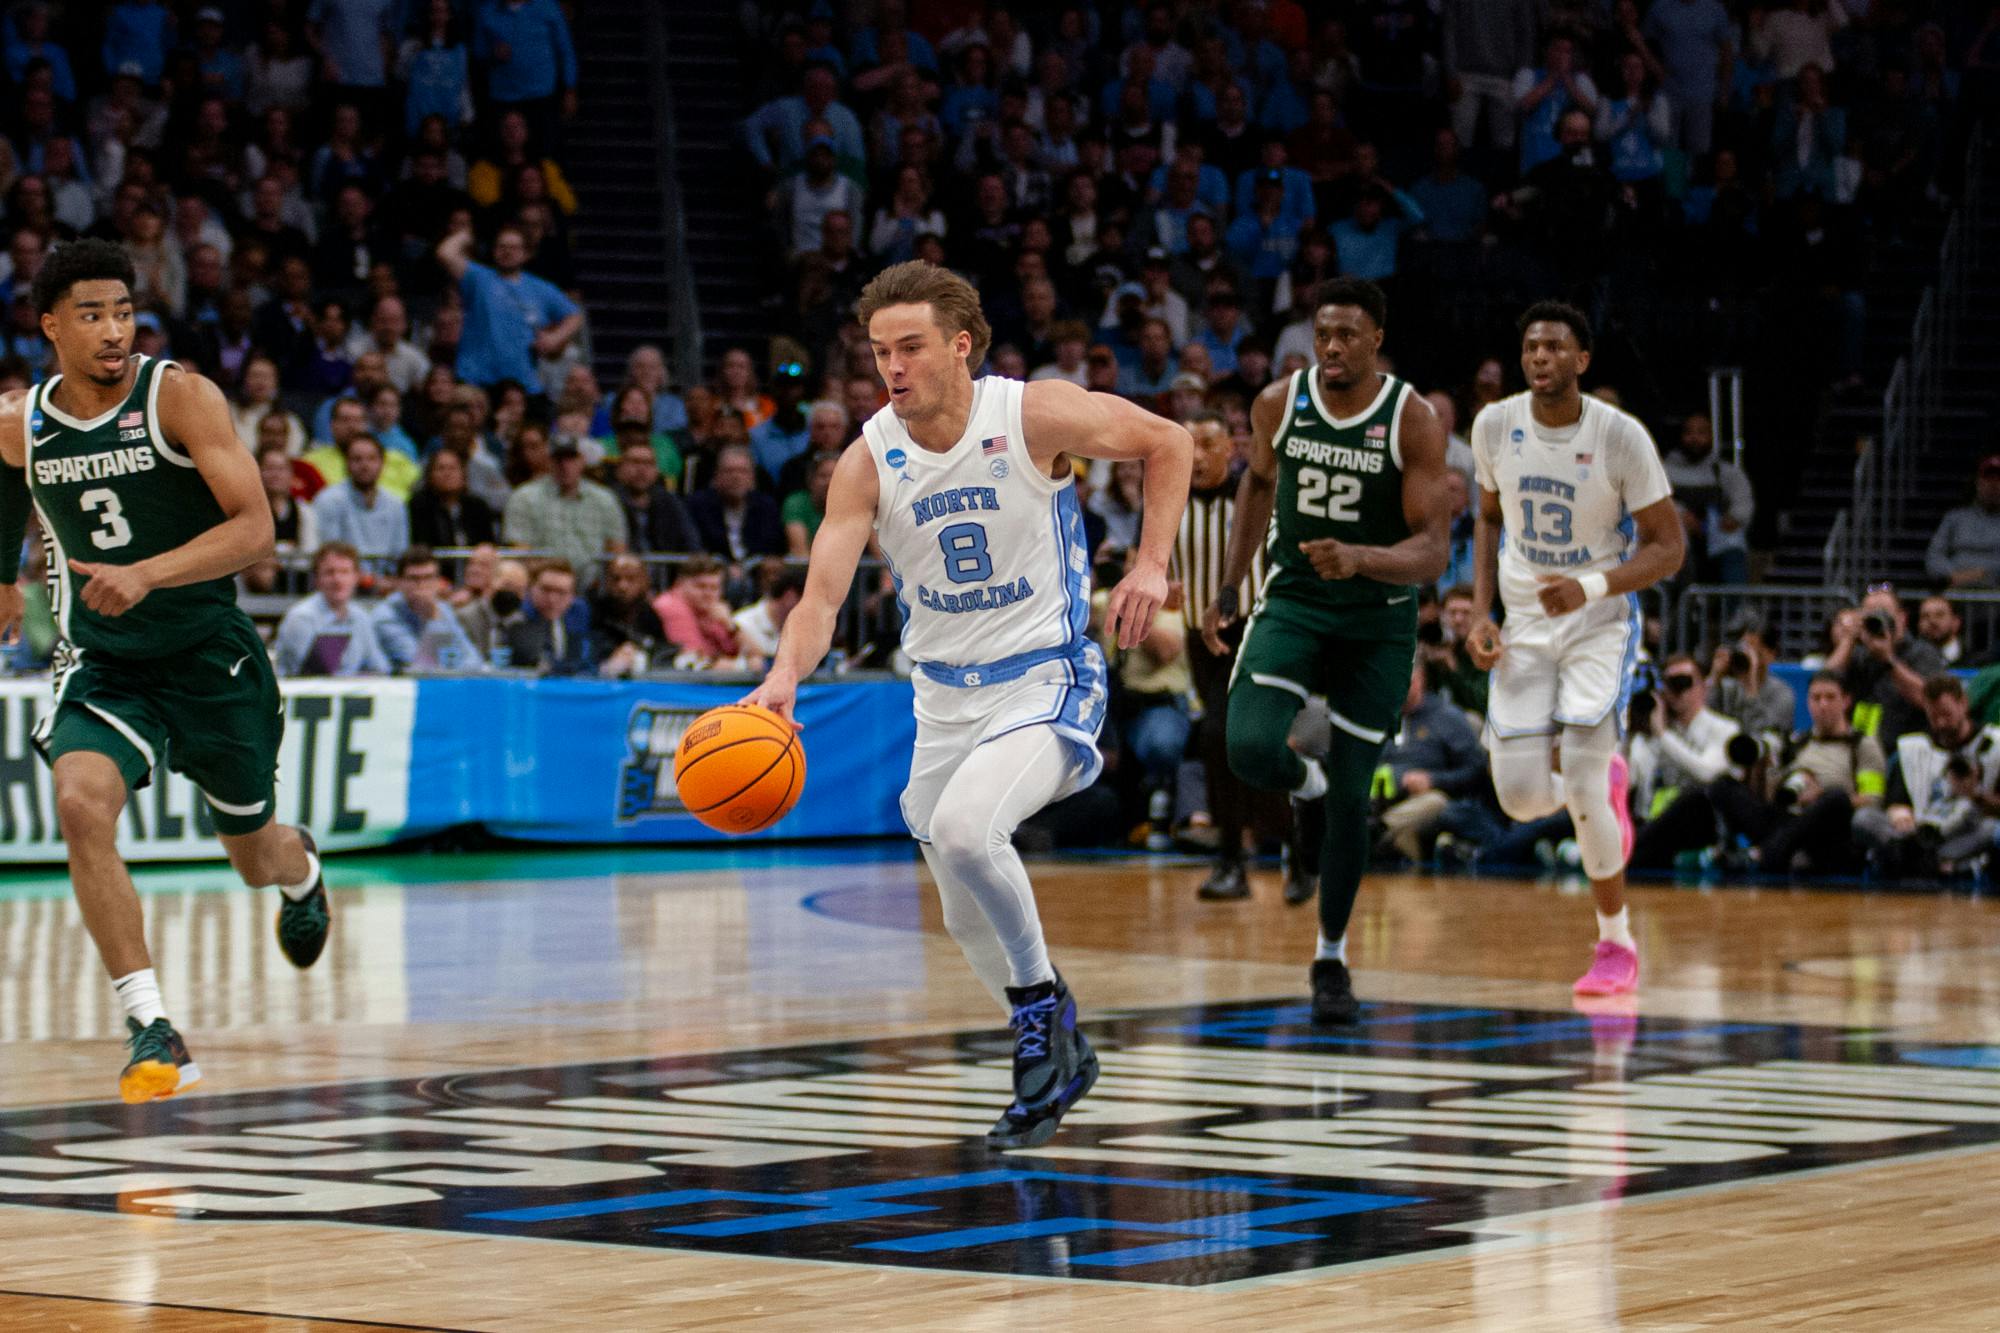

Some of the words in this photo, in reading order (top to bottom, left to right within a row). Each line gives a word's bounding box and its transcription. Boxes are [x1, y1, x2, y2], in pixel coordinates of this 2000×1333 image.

[34, 446, 156, 485] SPARTANS
[1285, 436, 1385, 474] SPARTANS
[912, 487, 1000, 526] NORTH
[1297, 466, 1362, 522] 22
[1518, 475, 1575, 502] NORTH
[80, 488, 133, 550] 3
[1520, 499, 1573, 545] 13
[938, 522, 993, 584] 8
[1514, 537, 1592, 567] AROLINA
[918, 576, 1034, 614] CAROLINA
